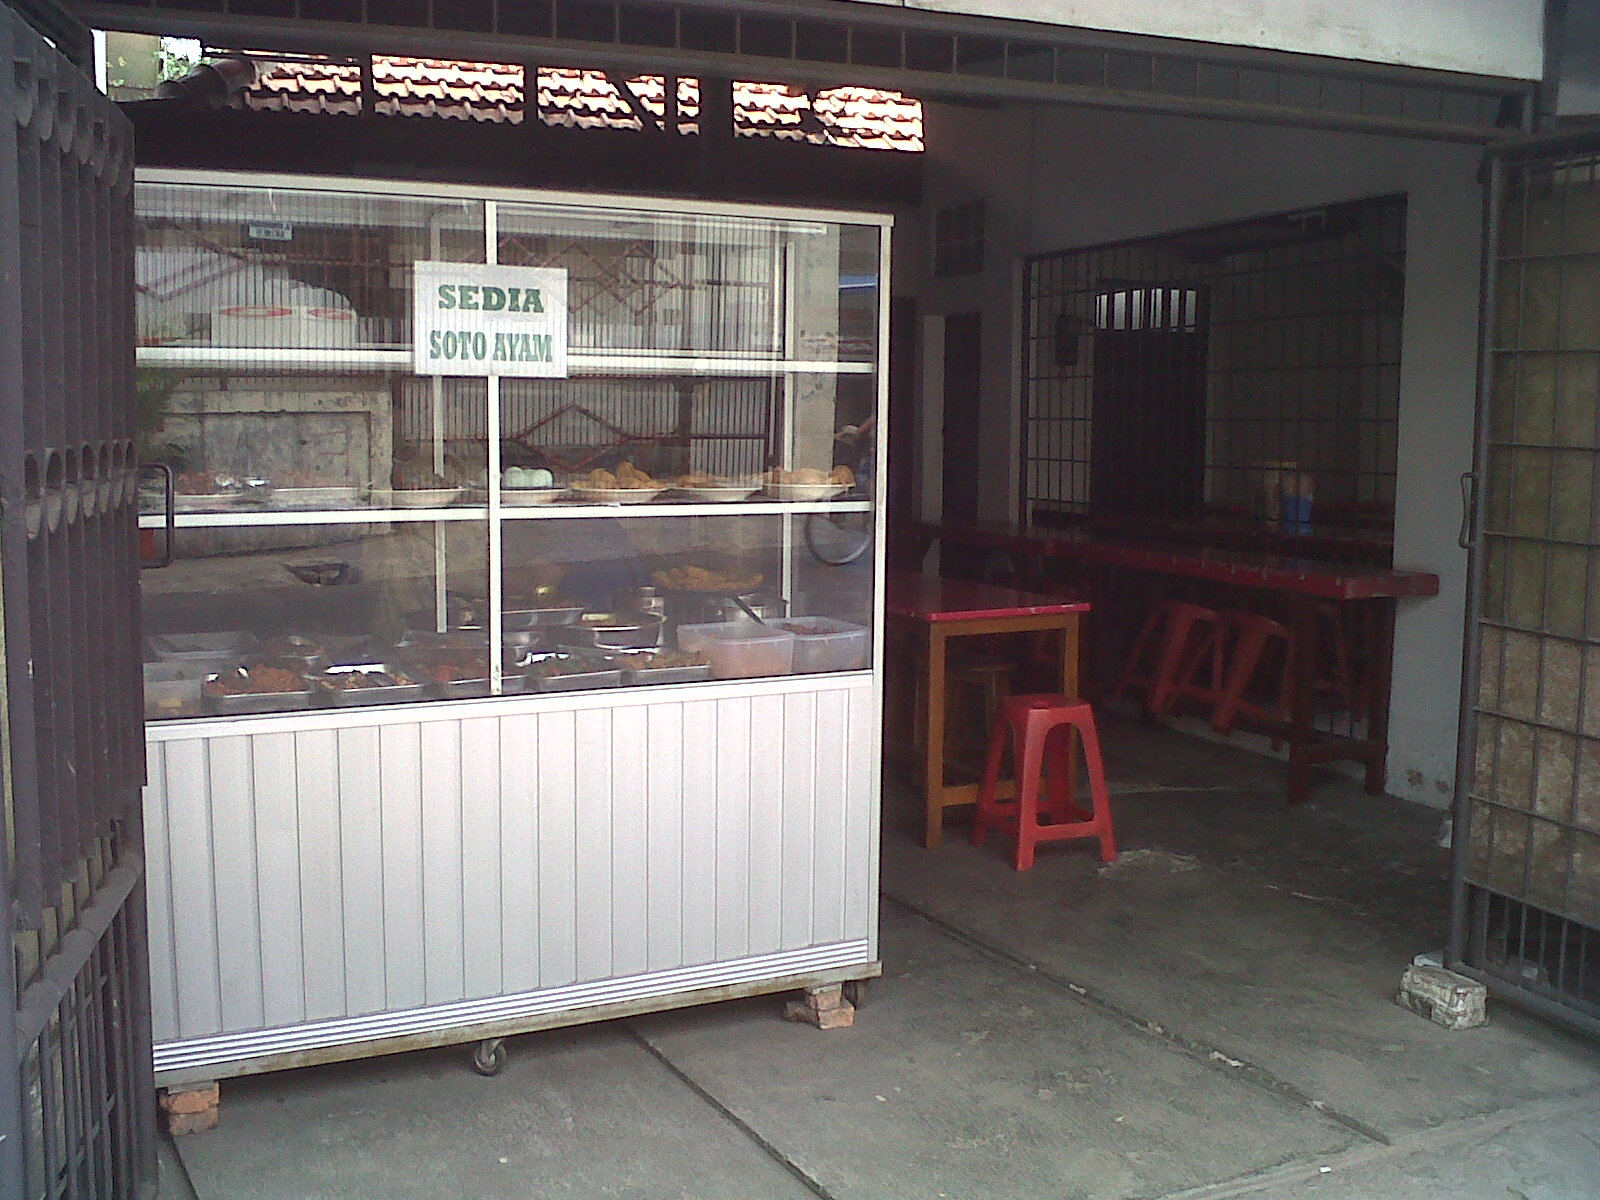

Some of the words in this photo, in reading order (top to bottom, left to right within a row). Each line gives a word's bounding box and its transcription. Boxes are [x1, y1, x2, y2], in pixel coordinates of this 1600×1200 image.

[438, 284, 544, 313] SEDIA
[430, 330, 487, 360] SOTO
[493, 332, 553, 363] AYAM
